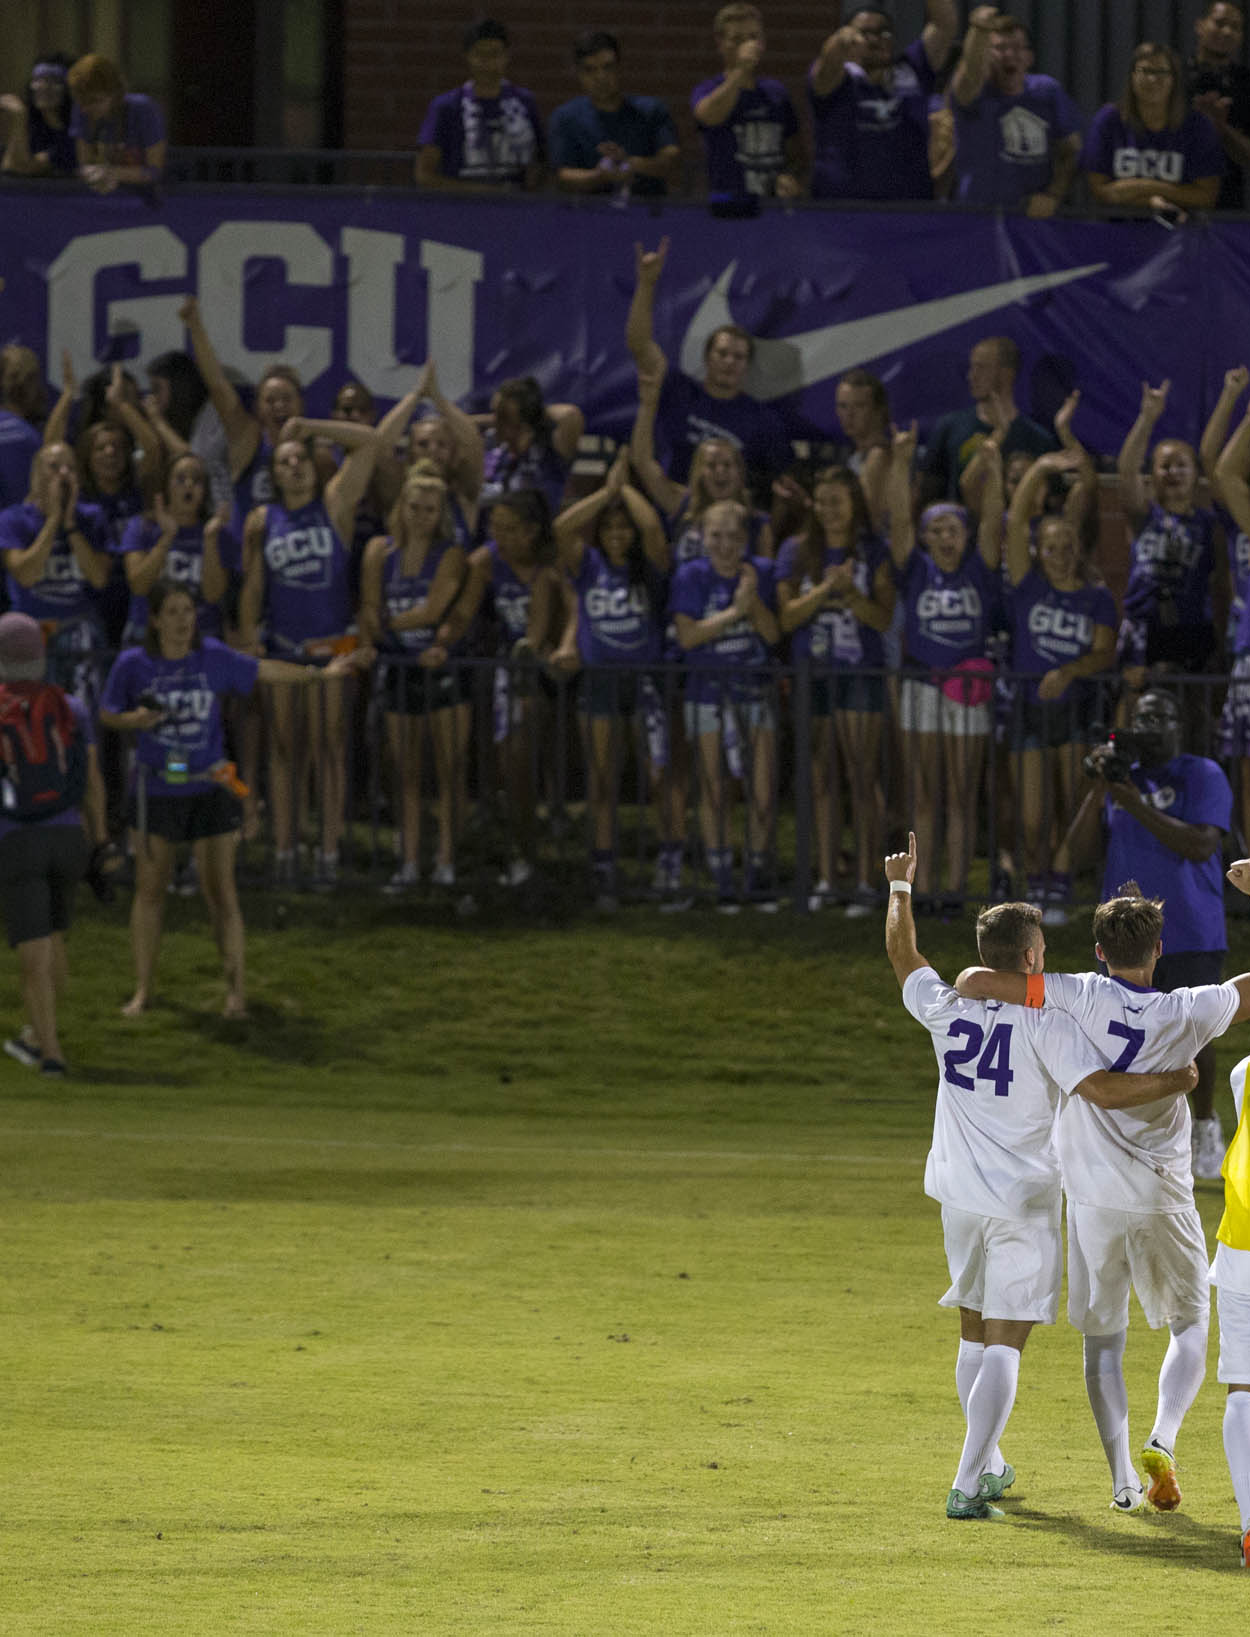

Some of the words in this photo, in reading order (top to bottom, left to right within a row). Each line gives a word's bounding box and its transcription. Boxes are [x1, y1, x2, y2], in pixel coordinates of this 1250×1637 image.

[1112, 147, 1184, 184] GCU
[47, 221, 483, 402] GCU
[264, 525, 334, 571] GCU
[584, 586, 648, 618] GCU
[916, 586, 983, 617] GCU
[1027, 602, 1095, 647] GCU
[944, 1017, 1014, 1097] 24
[1107, 1019, 1146, 1074] 7
